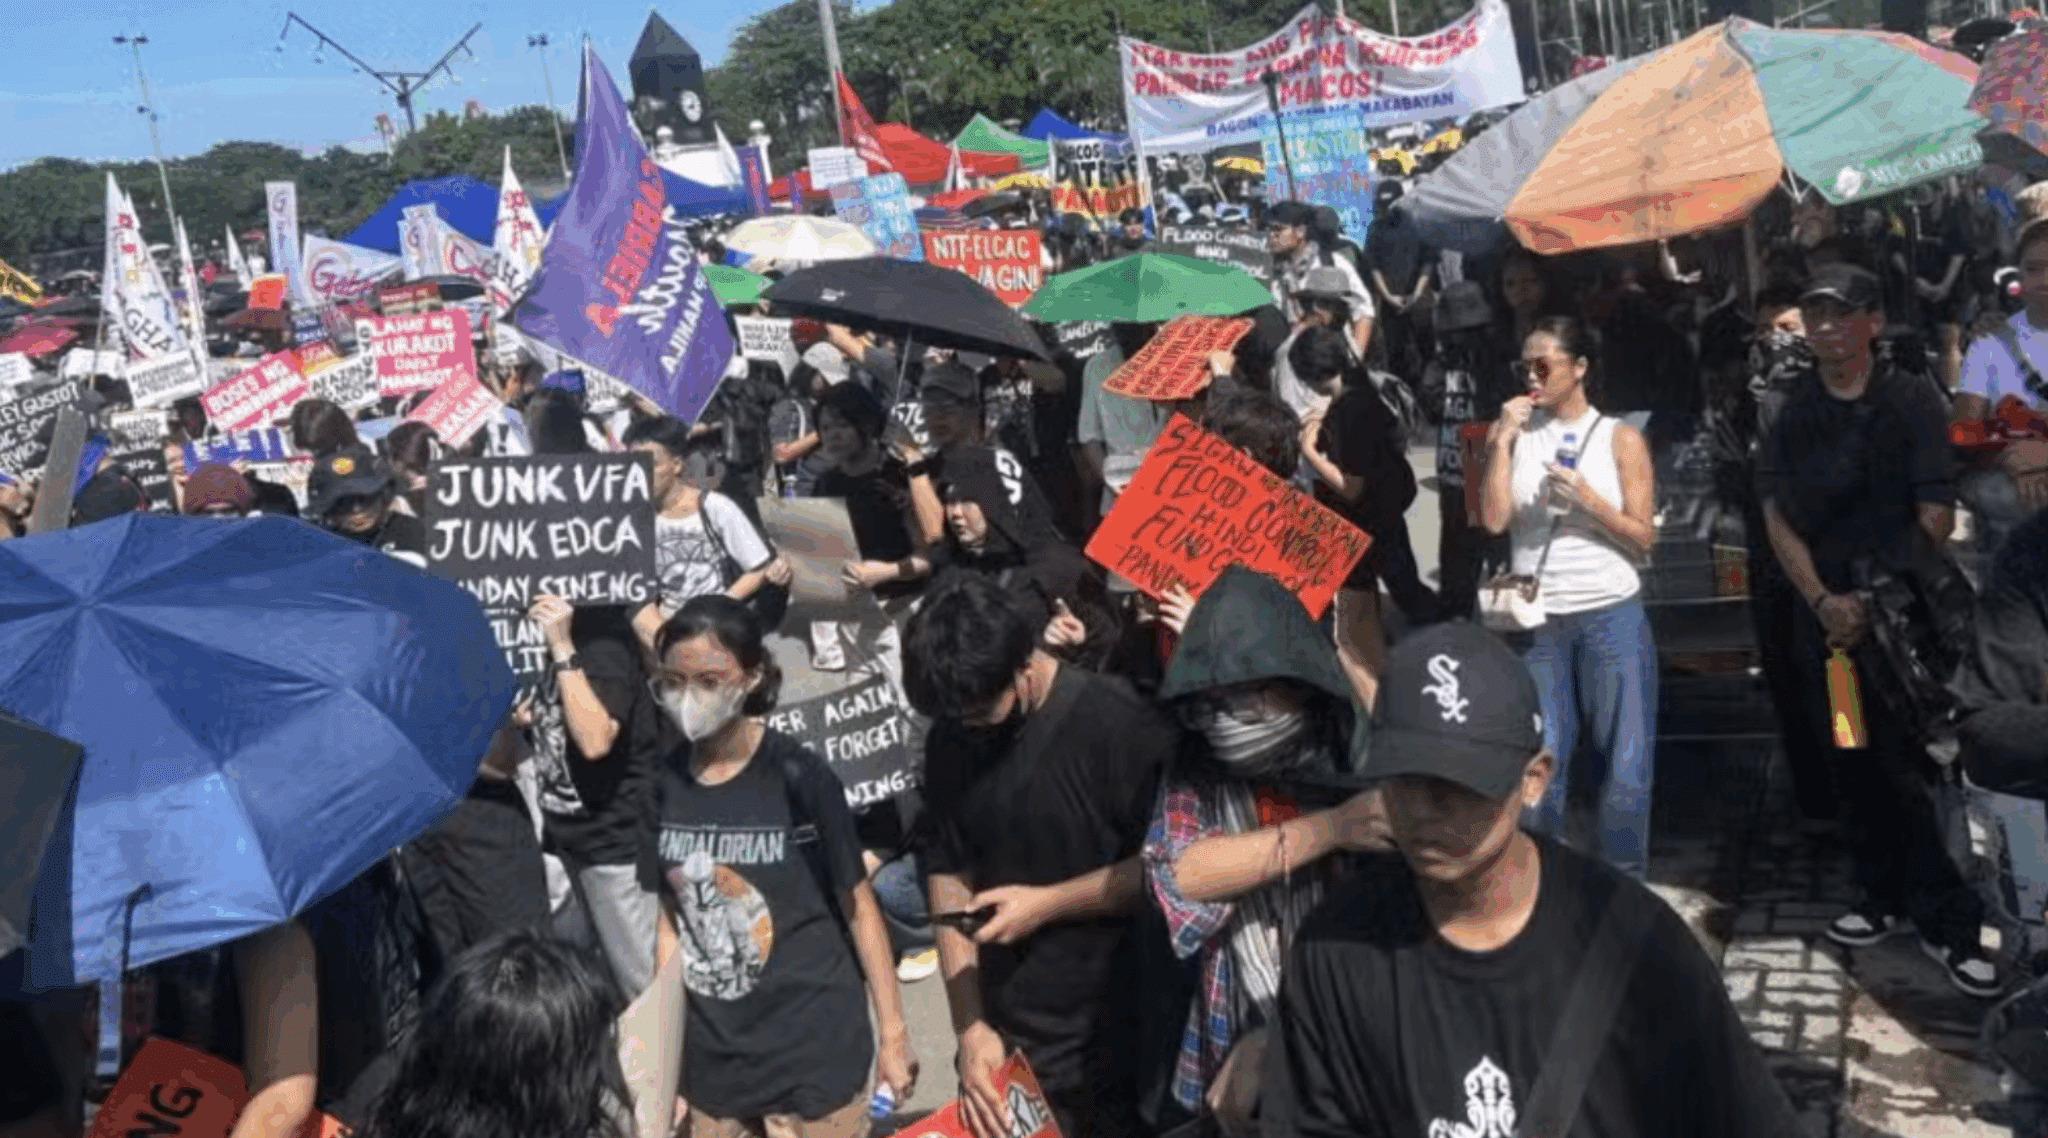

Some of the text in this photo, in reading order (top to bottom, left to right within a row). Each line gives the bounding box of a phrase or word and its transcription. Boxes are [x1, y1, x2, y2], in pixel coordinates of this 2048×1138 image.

[932, 234, 1031, 261] NTF-ELCAC
[1162, 226, 1213, 244] FLOOD
[1155, 422, 1257, 477] SIGAW
[437, 461, 650, 508] JUNK VFA
[1154, 455, 1249, 509] FLOOD
[430, 514, 643, 561] JUNK EDCA
[823, 684, 897, 727] AGAIN
[825, 715, 902, 763] FORGET
